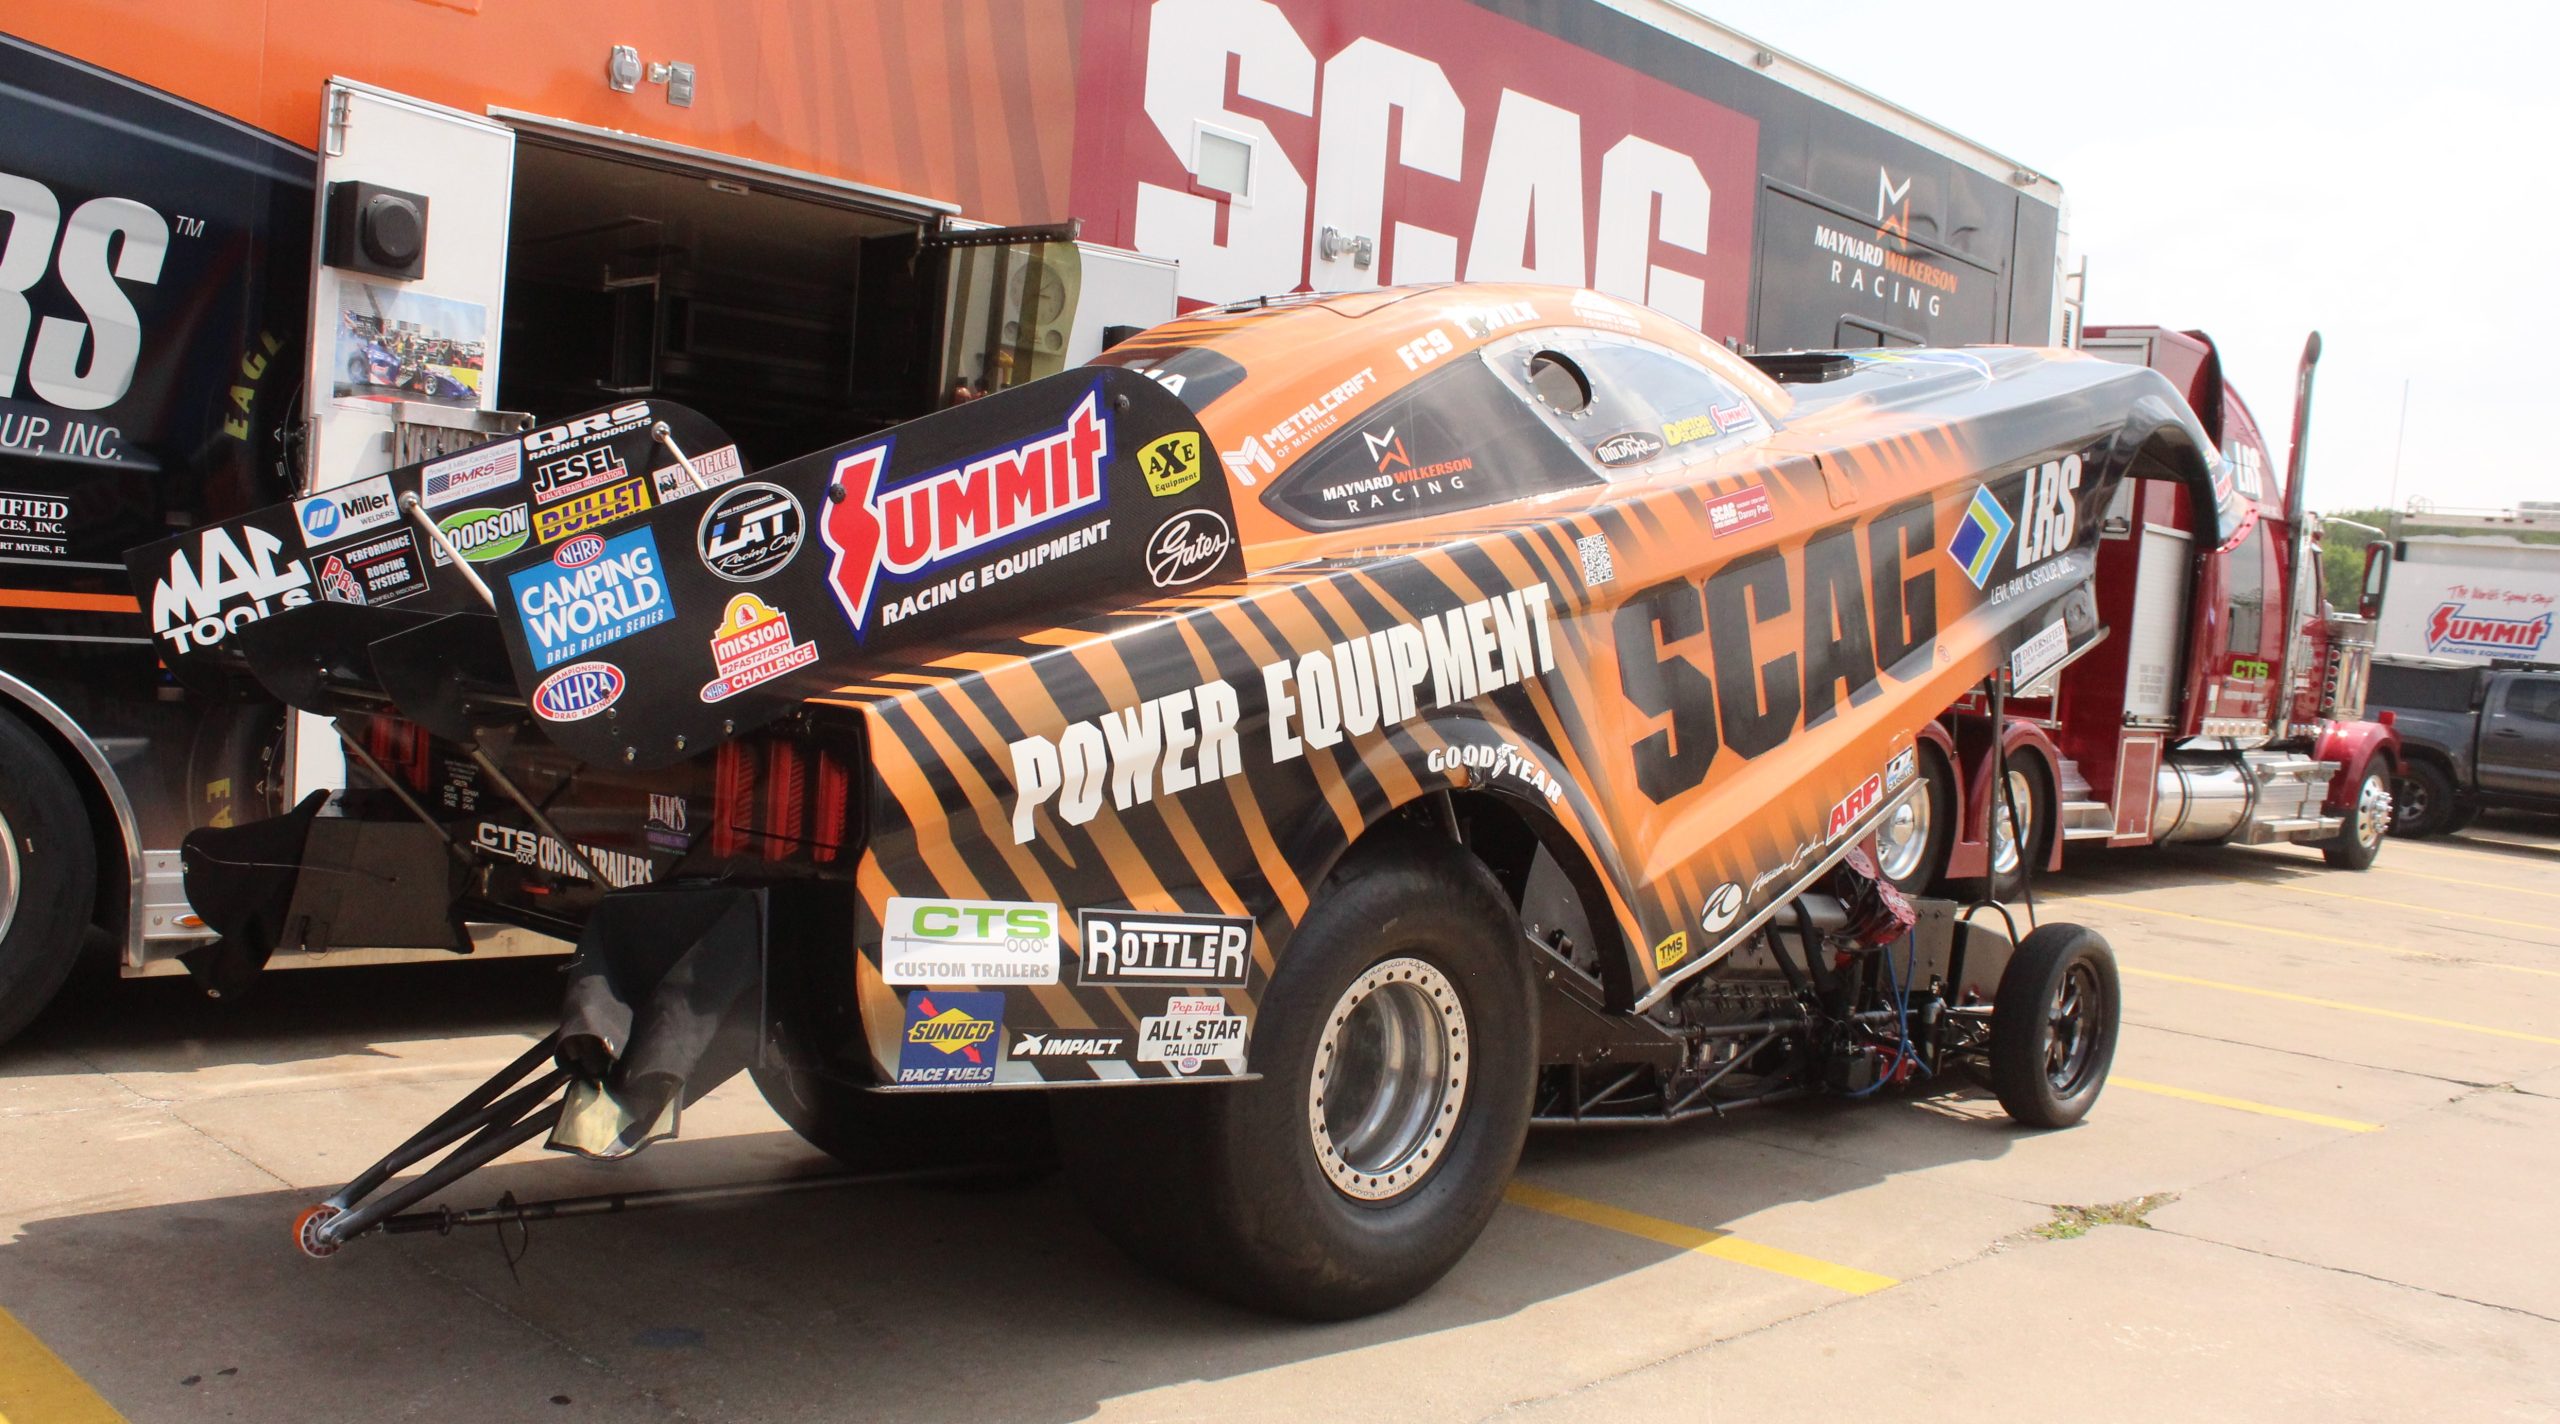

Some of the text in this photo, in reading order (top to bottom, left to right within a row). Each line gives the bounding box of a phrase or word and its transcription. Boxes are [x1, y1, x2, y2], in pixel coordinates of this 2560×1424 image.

[1135, 0, 1711, 331] SCAG
[1814, 225, 1958, 294] MAYNARD WILKERSON
[1831, 260, 1940, 317] RACING
[1396, 328, 1453, 372] FC9
[523, 400, 650, 451] QRS
[1262, 367, 1377, 449] METALCRAFT
[0, 413, 122, 461] UP, INC.
[529, 418, 652, 461] RACING PRODUCTS
[1276, 414, 1338, 459] OF MAYVILLE
[450, 461, 495, 487] BMRS
[534, 447, 620, 493] JESEL
[1148, 440, 1196, 479] AXE
[1322, 457, 1473, 502] MAYNARD WILKERSON
[2232, 441, 2263, 500] LRS
[539, 469, 624, 501] VALVETRAIN INNOVATION
[666, 473, 727, 501] EQUIPENT
[1154, 471, 1198, 492] Equipment
[1347, 476, 1464, 513] RACING
[341, 493, 390, 519] Miller
[360, 510, 395, 525] WELDERS
[541, 481, 643, 540] BULLET
[732, 494, 774, 513] PERFORMANCE
[2016, 453, 2082, 570] LRS
[35, 521, 66, 534] INC.
[708, 499, 792, 560] LAT
[346, 534, 411, 564] PERFORMANCE
[366, 557, 406, 579] ROOFING
[560, 539, 601, 564] NHRA
[717, 546, 768, 570] Racing
[769, 532, 798, 551] Oils
[1153, 519, 1229, 582] Gates
[152, 525, 312, 633] MAC
[321, 555, 361, 598] PRS
[369, 569, 410, 592] SYSTEMS
[521, 546, 653, 616] CAMPING
[882, 519, 1110, 627] RACING EQUIPMENT
[2010, 577, 2025, 597] RAY
[528, 575, 662, 648] WORLD
[546, 608, 664, 665] DRAG RACING SERIES
[717, 620, 787, 661] MISSION
[1612, 492, 1937, 805] SCAG
[2440, 646, 2536, 661] RACING EQUIPMENT
[546, 664, 605, 687] CHAMPIONSHIP
[705, 646, 813, 698] NHRA CHALLENGE
[721, 641, 792, 675] #2FAST2TASTY
[2231, 659, 2269, 680] CTS
[548, 672, 613, 711] NHRA
[554, 699, 611, 720] DRAG RACING
[1008, 581, 1556, 845] POWER EQUIPMENT
[1427, 744, 1563, 805] GOODYEAR
[1827, 774, 1880, 838] ARP
[478, 822, 537, 856] CTS
[590, 846, 653, 889] TRAILERS
[912, 905, 1051, 939] CTS
[1087, 919, 1246, 979] ROTTLER
[1660, 937, 1683, 959] TMS
[894, 961, 1050, 979] CUSTOM TRAILERS
[1172, 1001, 1221, 1016] Pep Boys
[912, 1022, 992, 1041] SUNOCO
[1146, 1020, 1242, 1041] ALL STAR
[1164, 1043, 1218, 1057] CALLOUT
[900, 1066, 993, 1082] RACE FUELS
